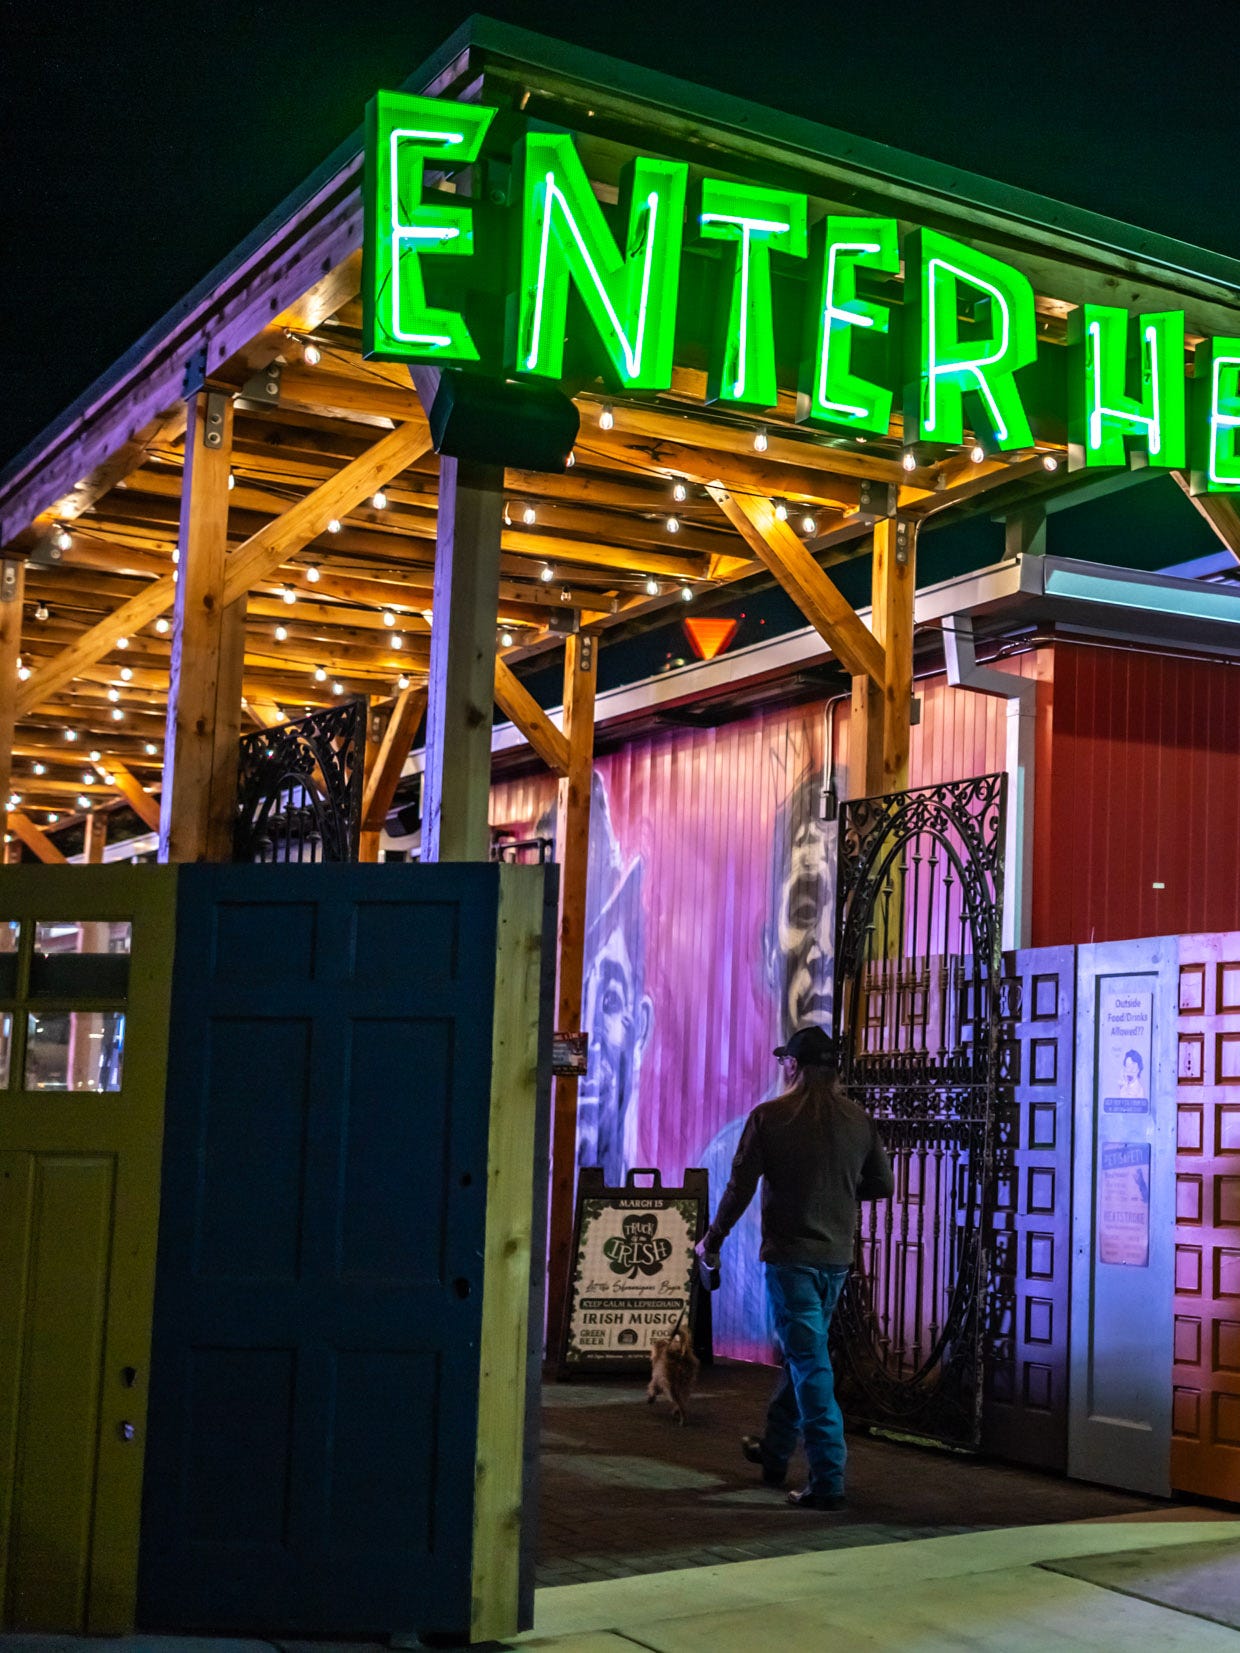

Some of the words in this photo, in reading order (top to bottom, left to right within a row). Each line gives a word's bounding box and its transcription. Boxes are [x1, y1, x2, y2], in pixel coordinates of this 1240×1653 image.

[374, 90, 1037, 450] ENTER
[1115, 999, 1141, 1008] Outside
[619, 1200, 652, 1208] MARCH
[654, 1200, 664, 1208] 15
[624, 1223, 655, 1235] TRUCK
[606, 1240, 667, 1267] IRISH
[602, 1300, 625, 1308] CALM
[583, 1313, 624, 1325] IRISH
[629, 1313, 678, 1325] MUSIC
[580, 1329, 606, 1337] GREEN
[651, 1329, 673, 1337] FOO
